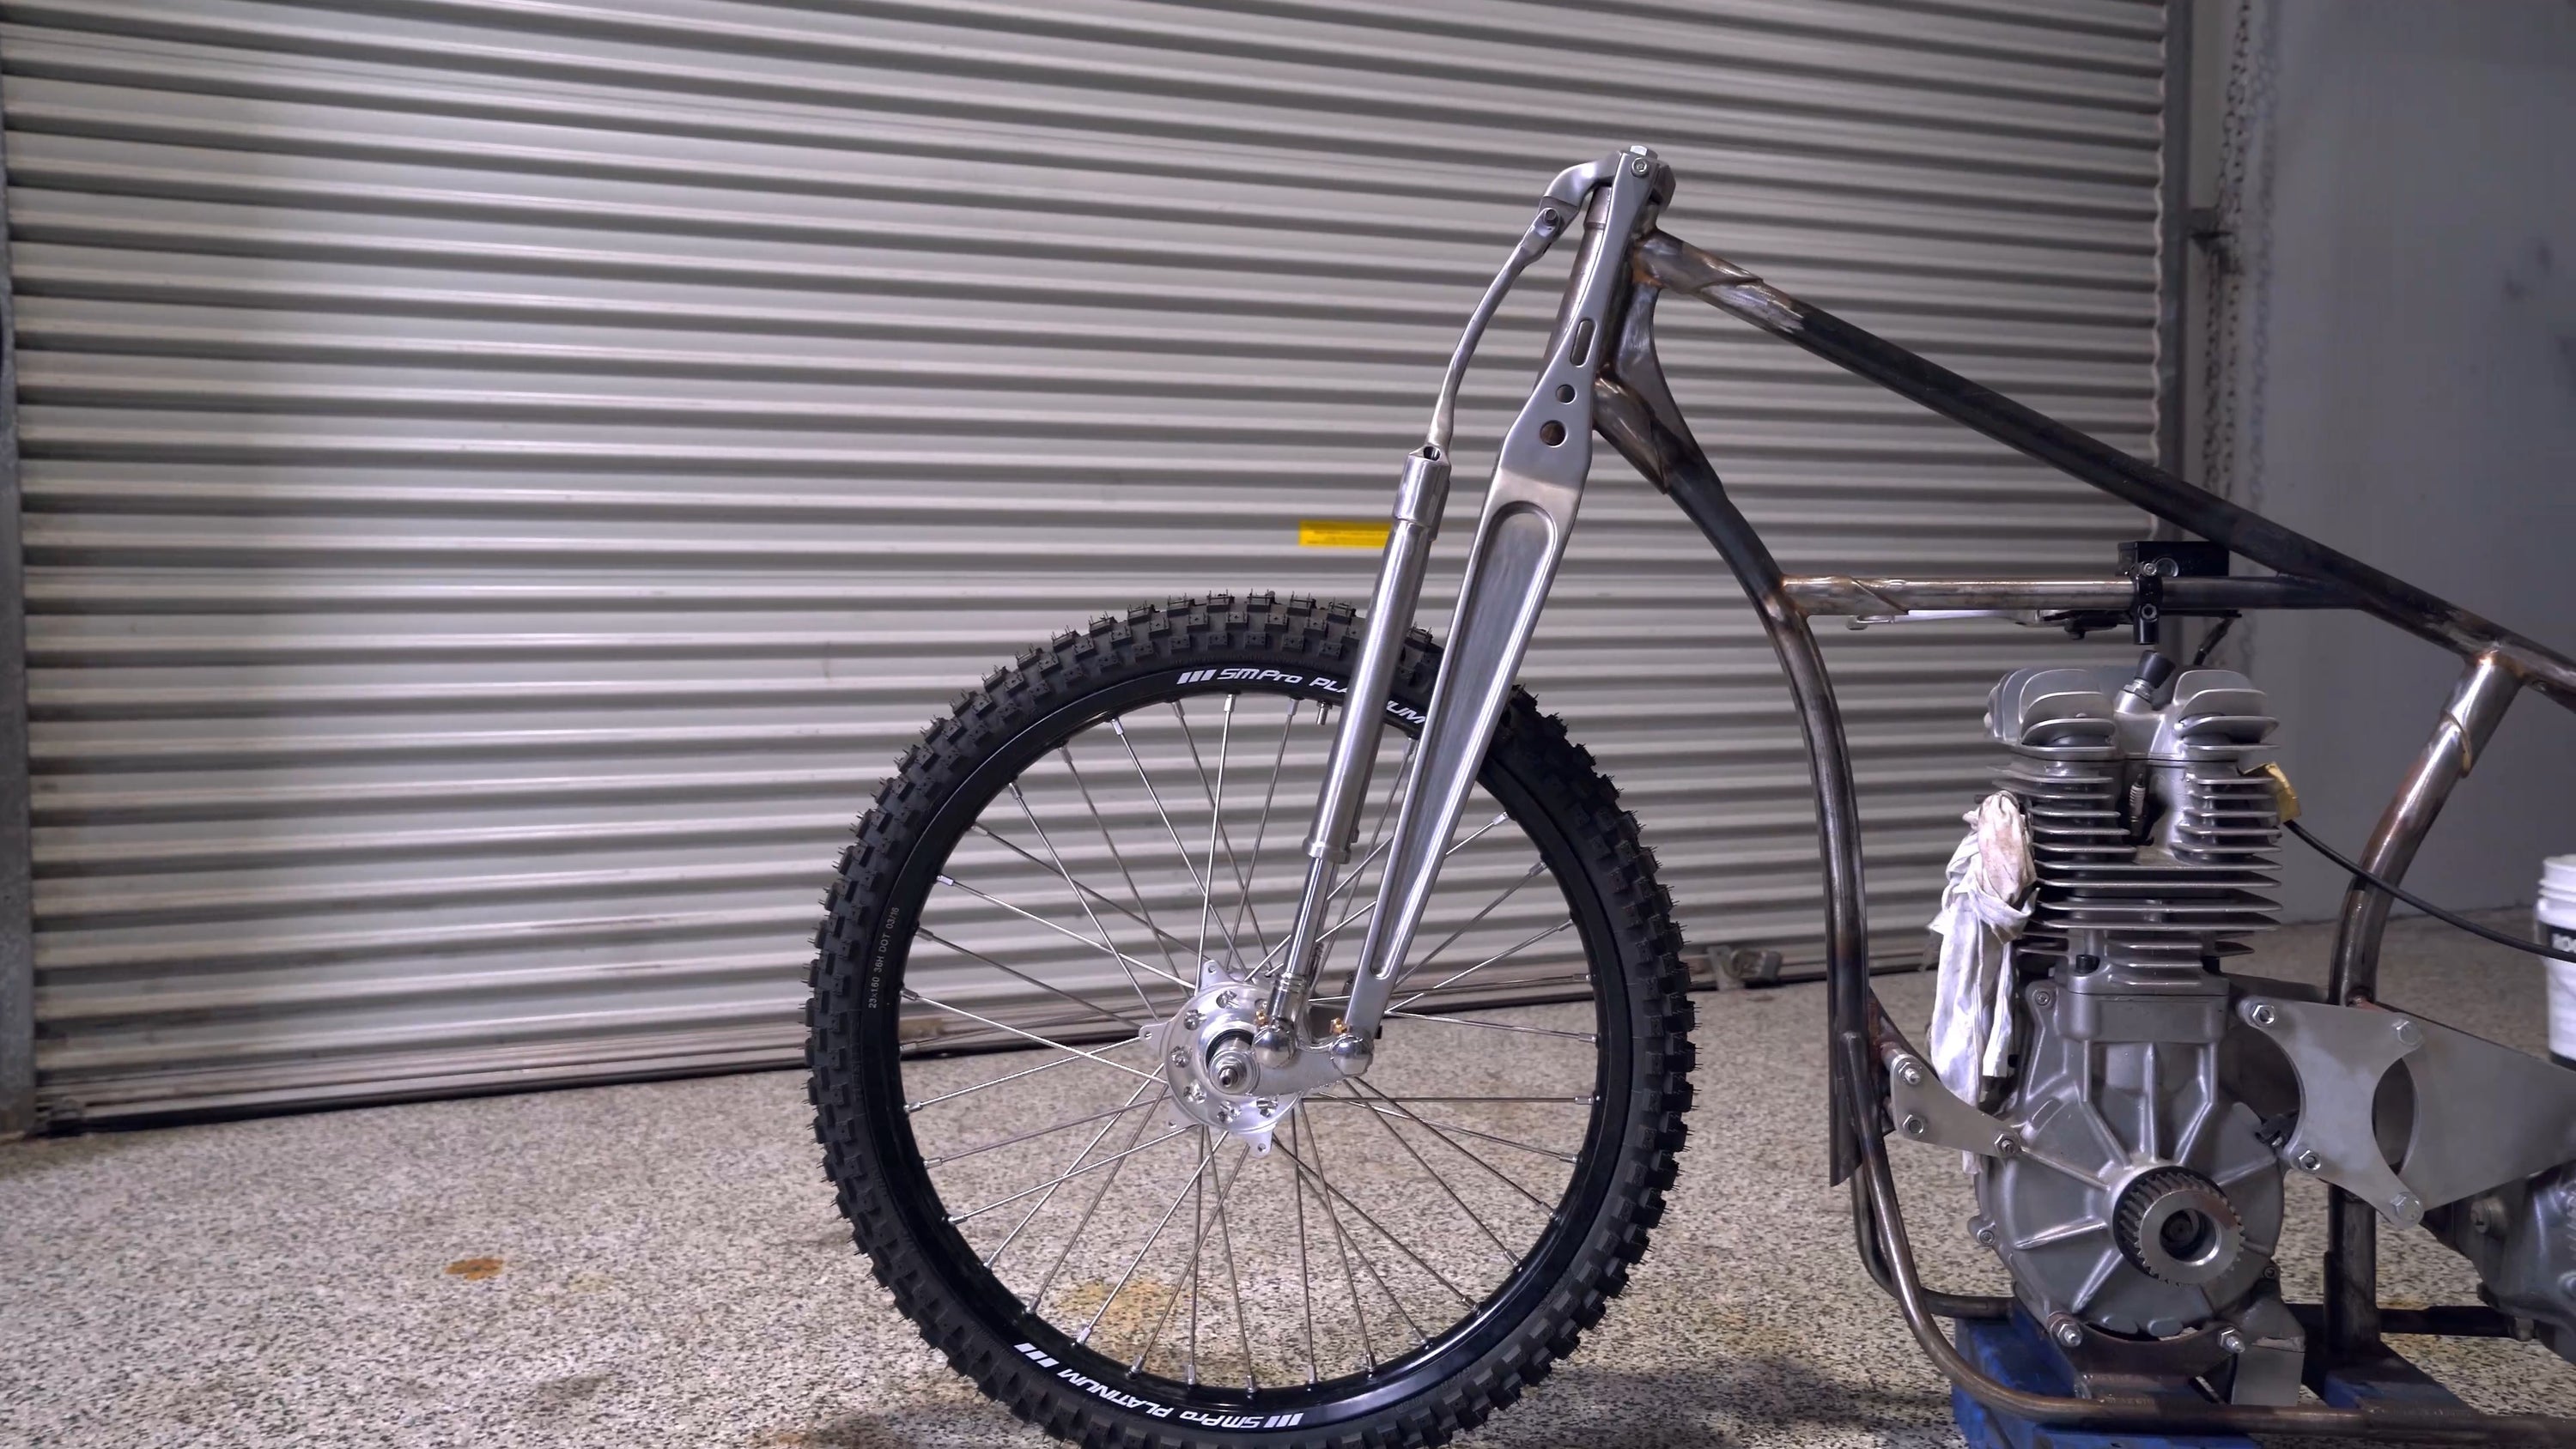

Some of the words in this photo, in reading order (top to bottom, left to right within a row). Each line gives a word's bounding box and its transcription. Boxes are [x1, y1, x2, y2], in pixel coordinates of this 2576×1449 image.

[878, 933, 890, 953] DOT
[873, 955, 884, 973] 36H
[1056, 1368, 1175, 1418] PLATINUM
